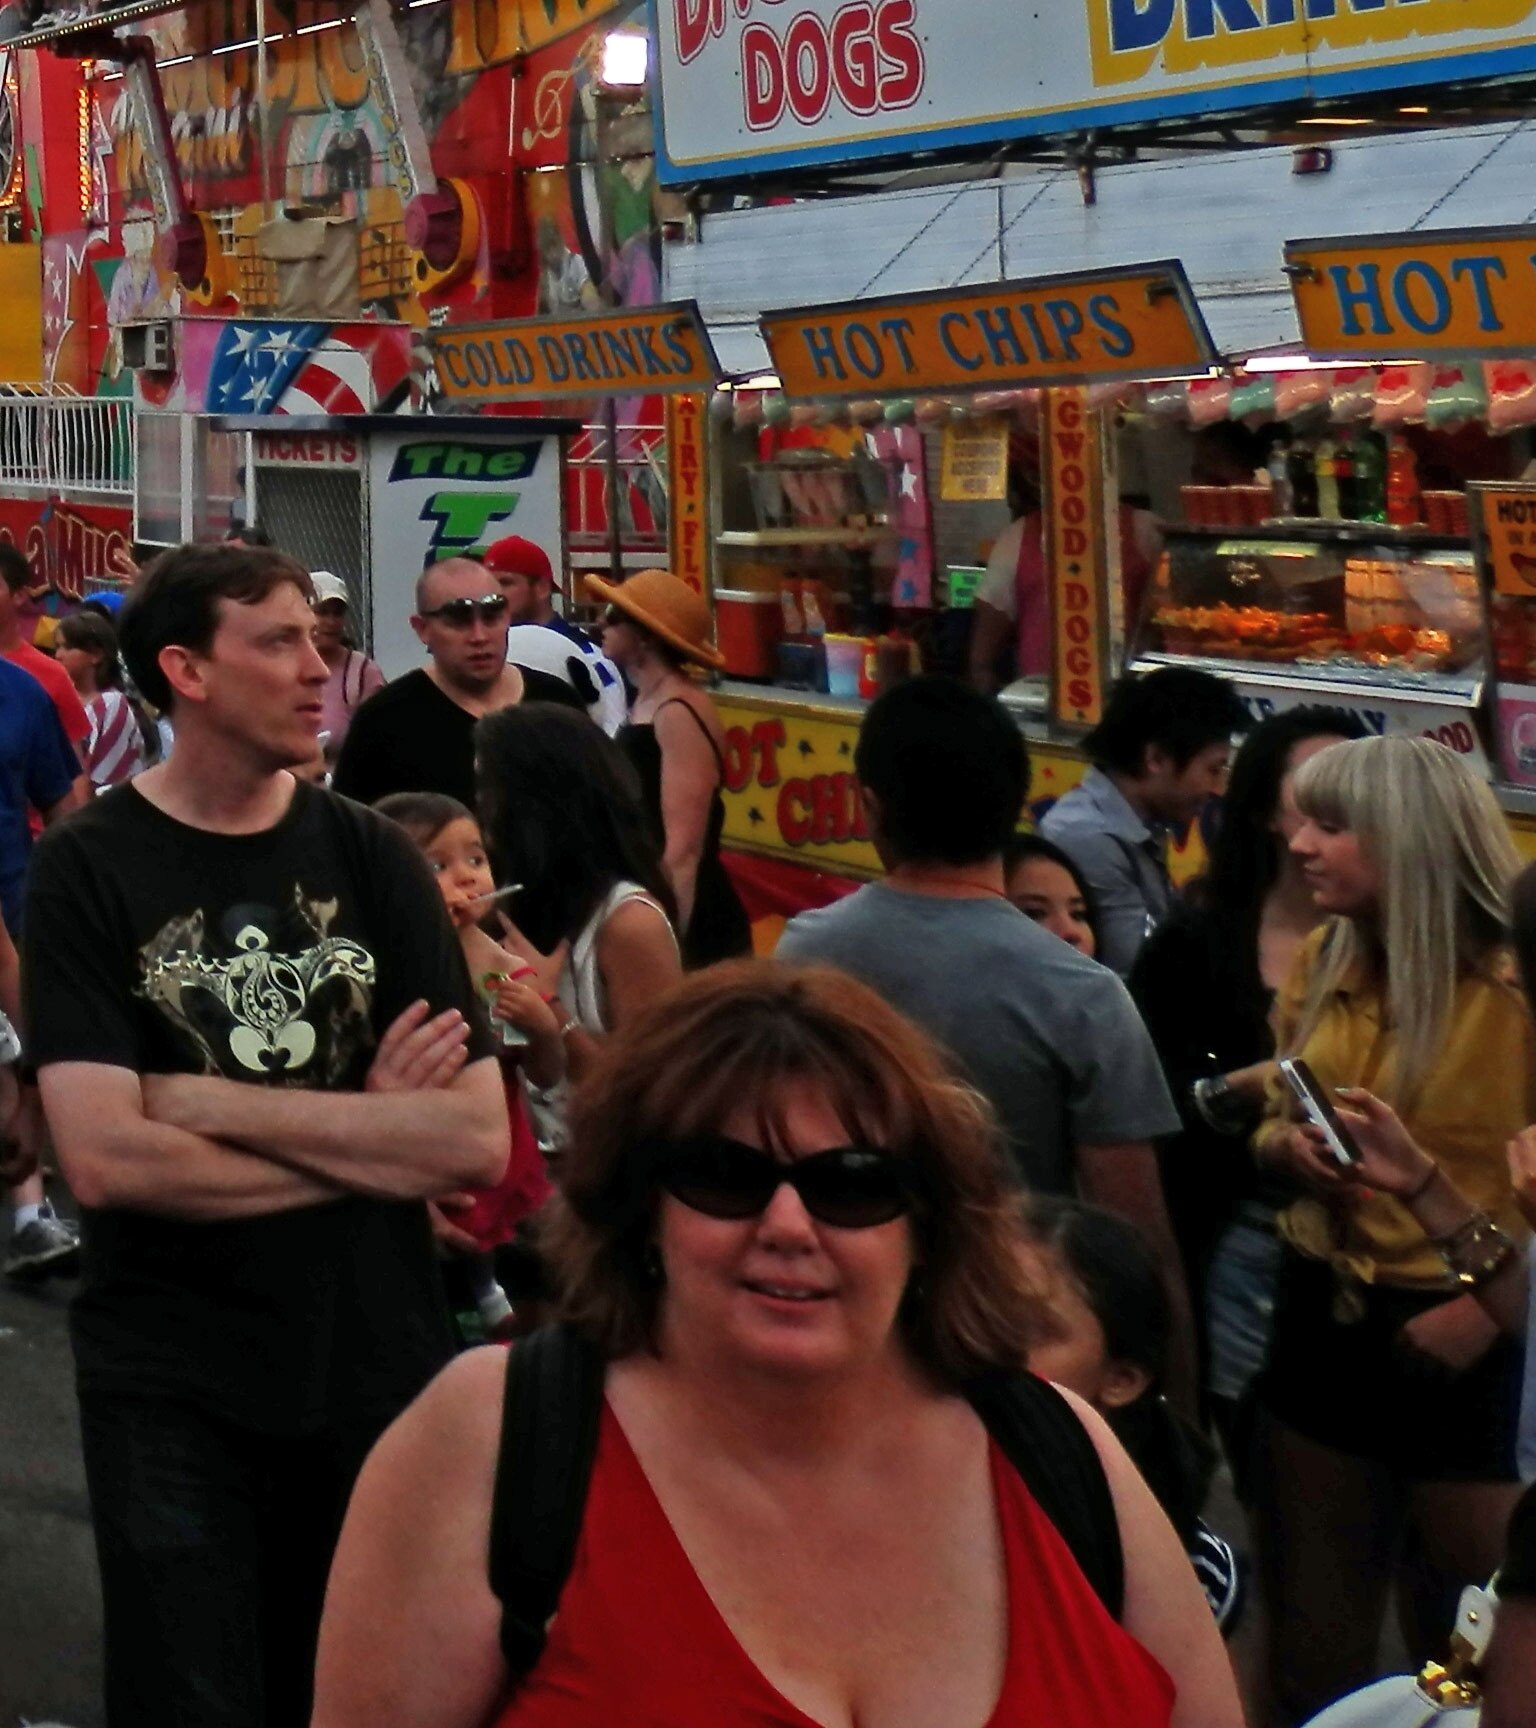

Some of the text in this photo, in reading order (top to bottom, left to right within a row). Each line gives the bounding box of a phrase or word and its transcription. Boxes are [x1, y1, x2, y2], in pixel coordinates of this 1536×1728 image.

[1327, 255, 1508, 336] HOT
[441, 322, 694, 389] COLD DRINKS
[801, 293, 1134, 381] HOT CHIPS
[257, 429, 358, 464] TICKETS
[403, 446, 526, 476] The
[1064, 582, 1092, 709] DOGS
